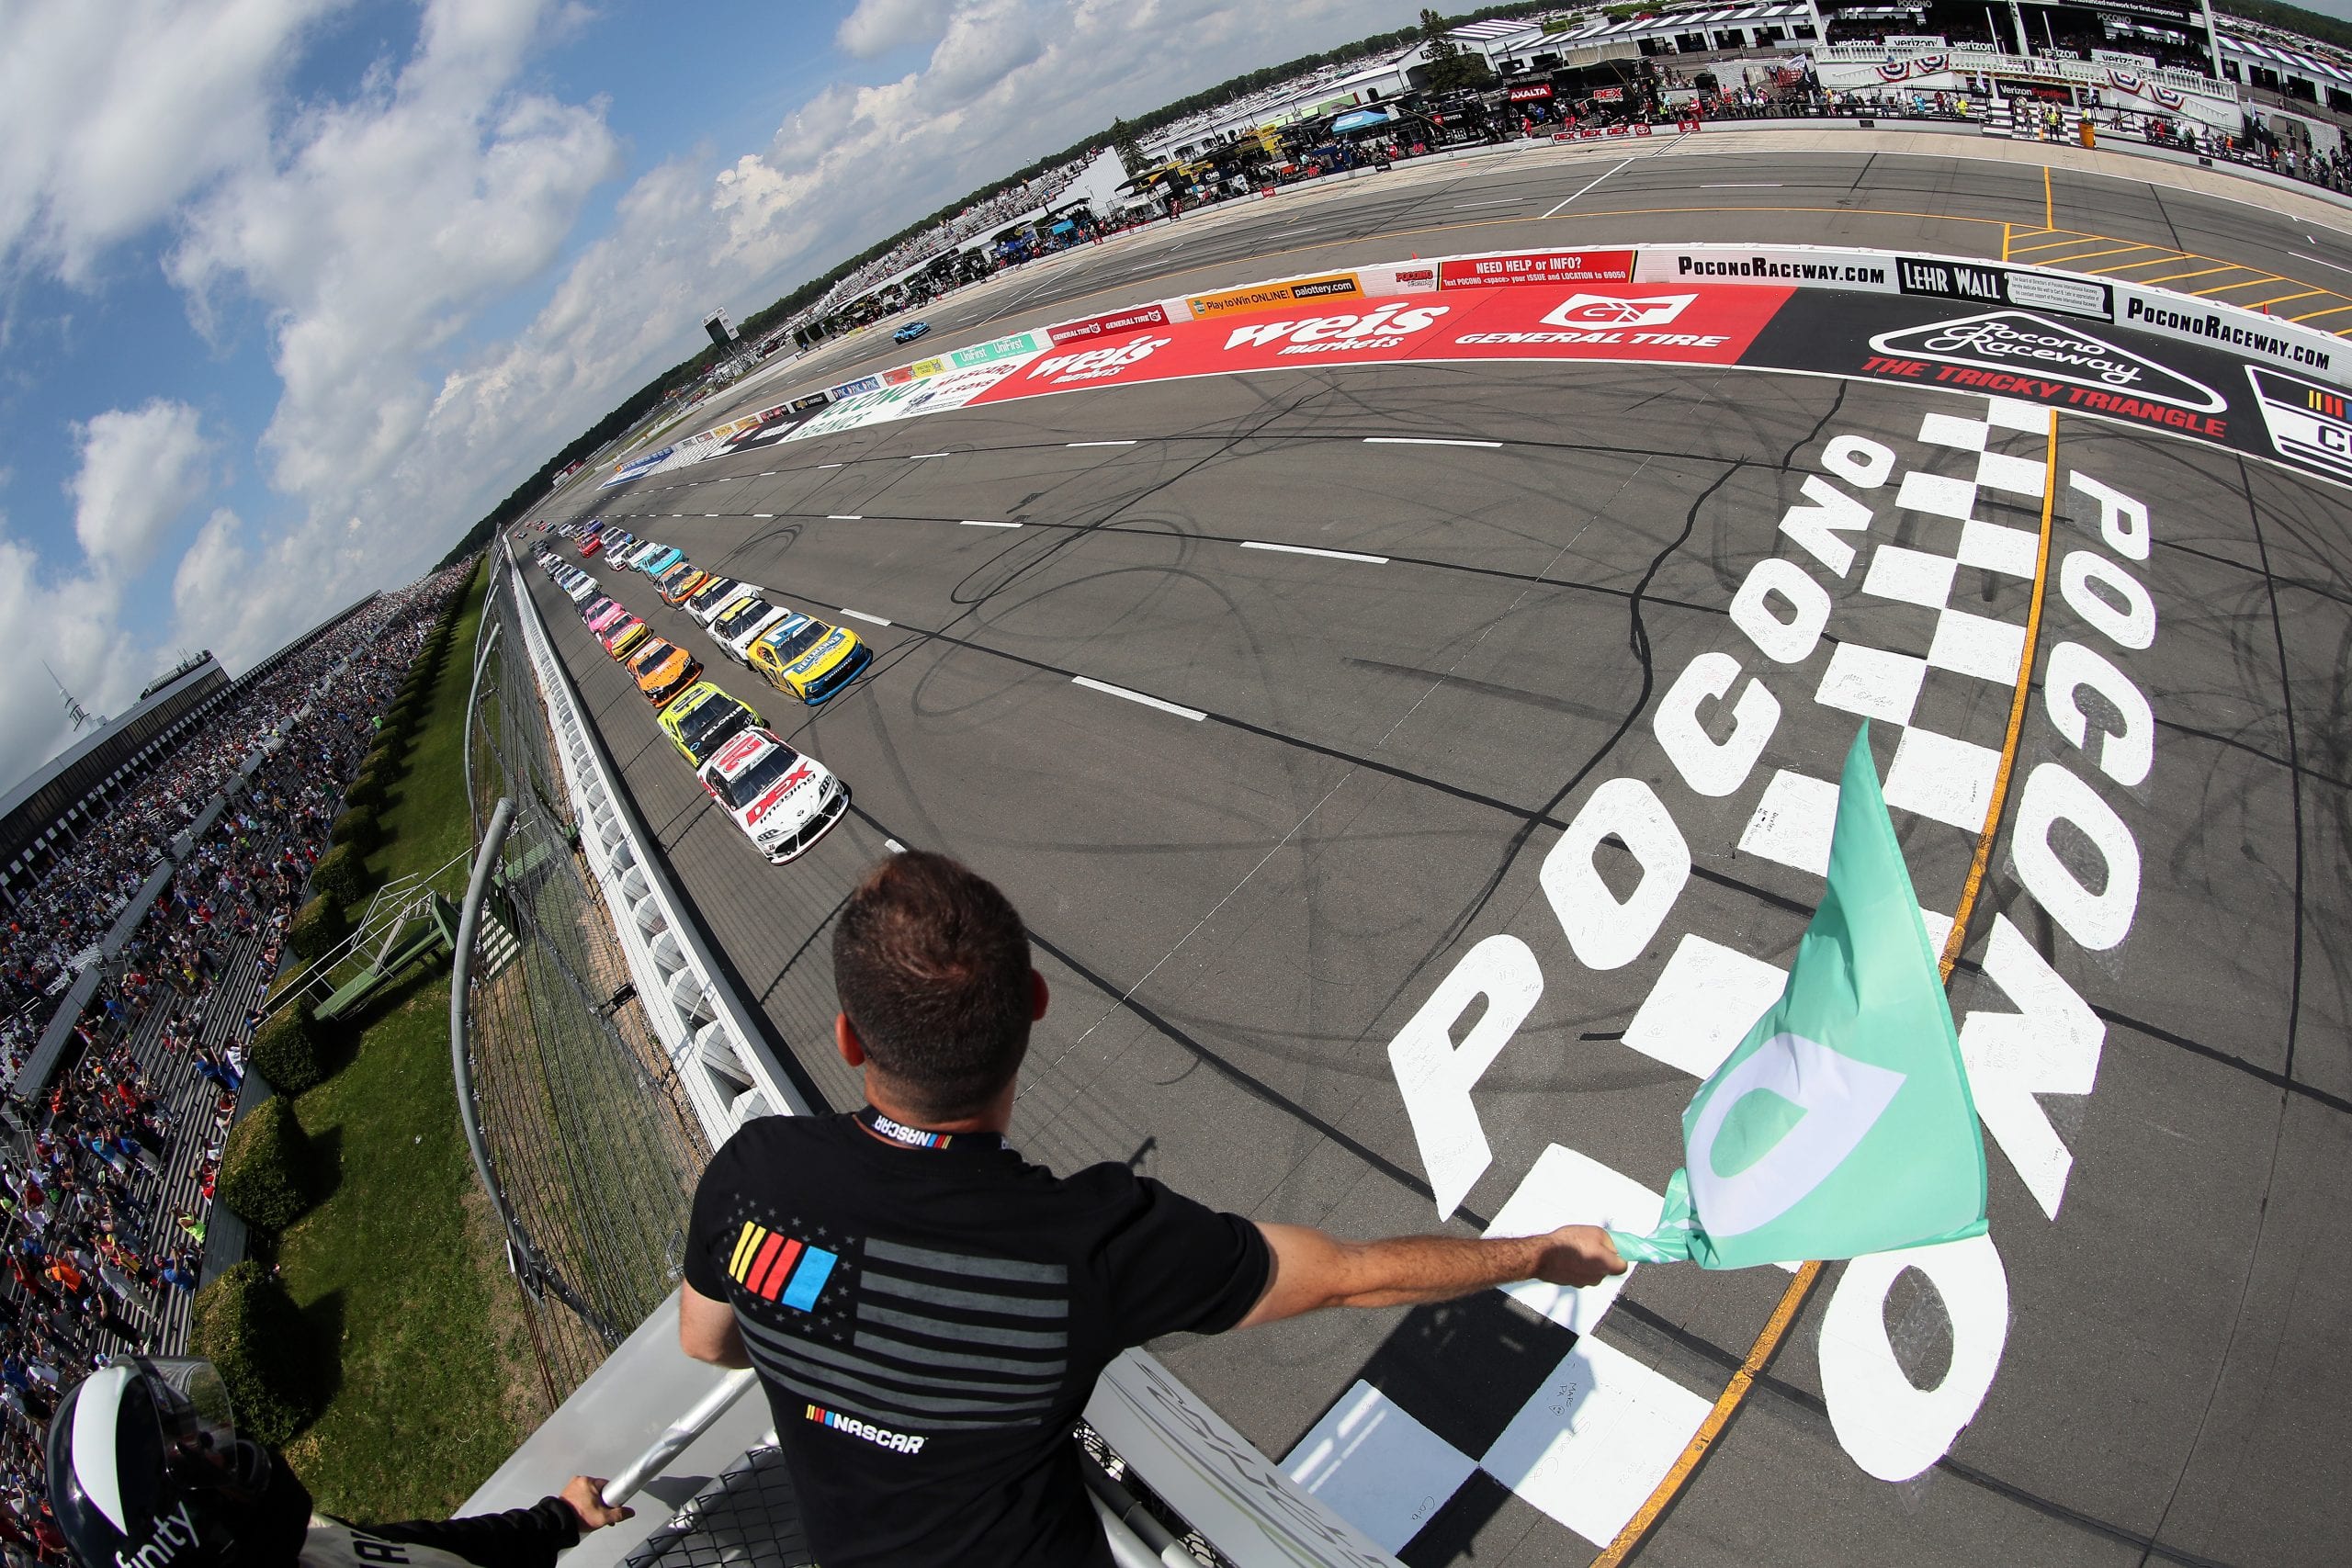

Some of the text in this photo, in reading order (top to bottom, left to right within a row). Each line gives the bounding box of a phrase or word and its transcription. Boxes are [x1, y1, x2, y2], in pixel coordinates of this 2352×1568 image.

[2097, 12, 2132, 24] POCONO
[1953, 40, 1995, 51] verizon
[1510, 87, 1548, 99] AXALTA
[1594, 87, 1623, 98] DEX
[1555, 131, 1576, 141] DEX
[1608, 127, 1629, 135] DEX
[1476, 257, 1581, 274] NEED HELP or INFO?
[1457, 276, 1481, 286] POCONO
[1483, 276, 1510, 285] <space>
[1527, 273, 1546, 281] ISSUE
[1561, 272, 1592, 280] LOCATION
[1903, 261, 2001, 299] LEHR WALL
[1295, 281, 1351, 299] palottery.com
[1206, 289, 1290, 310] Play to Win ONLINE!
[1105, 314, 1149, 329] GENERAL TIRE
[1224, 302, 1450, 350] weis
[1053, 327, 1091, 341] GENERAL TIRE
[1455, 333, 1731, 347] GENERAL TIRE
[1943, 321, 2105, 355] Pocono
[993, 339, 1023, 354] UniFirst
[1276, 335, 1404, 355] markets
[959, 348, 988, 362] UniFirst
[1026, 334, 1172, 378] weis
[1924, 334, 2142, 381] Raceway
[866, 380, 878, 390] PNC
[1861, 356, 2227, 438] THE TRICKY TRIANGLE
[746, 761, 813, 827] DEX
[759, 773, 816, 824] imaging
[1387, 434, 1895, 1222] POCONO
[875, 1115, 932, 1147] NASCAR
[832, 1413, 924, 1454] NASCAR
